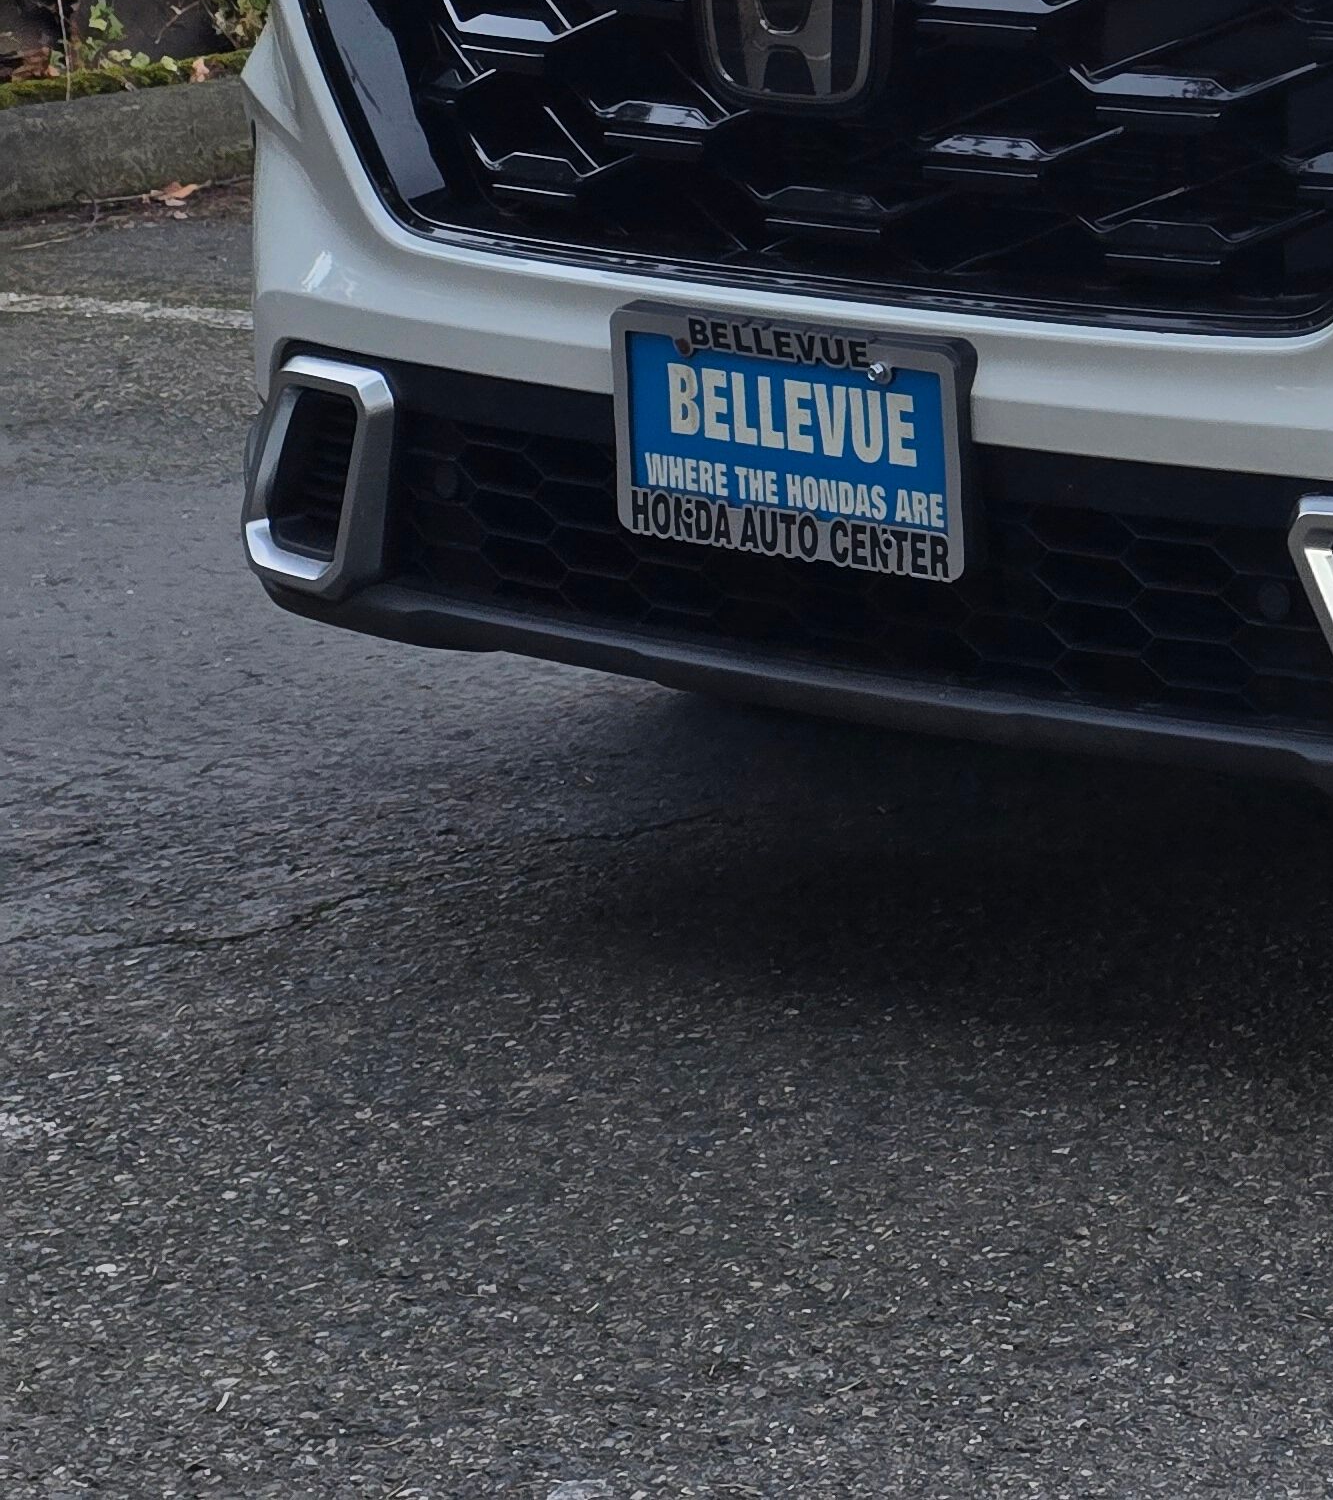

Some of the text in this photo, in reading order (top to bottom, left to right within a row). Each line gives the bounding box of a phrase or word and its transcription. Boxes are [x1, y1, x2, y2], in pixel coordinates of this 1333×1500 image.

[689, 317, 871, 367] BELLEVUE
[667, 363, 917, 467] BELLEVUE
[645, 452, 944, 527] WHERE THE HONDAS ARE
[631, 489, 948, 579] HONDA AUTO CENTER
